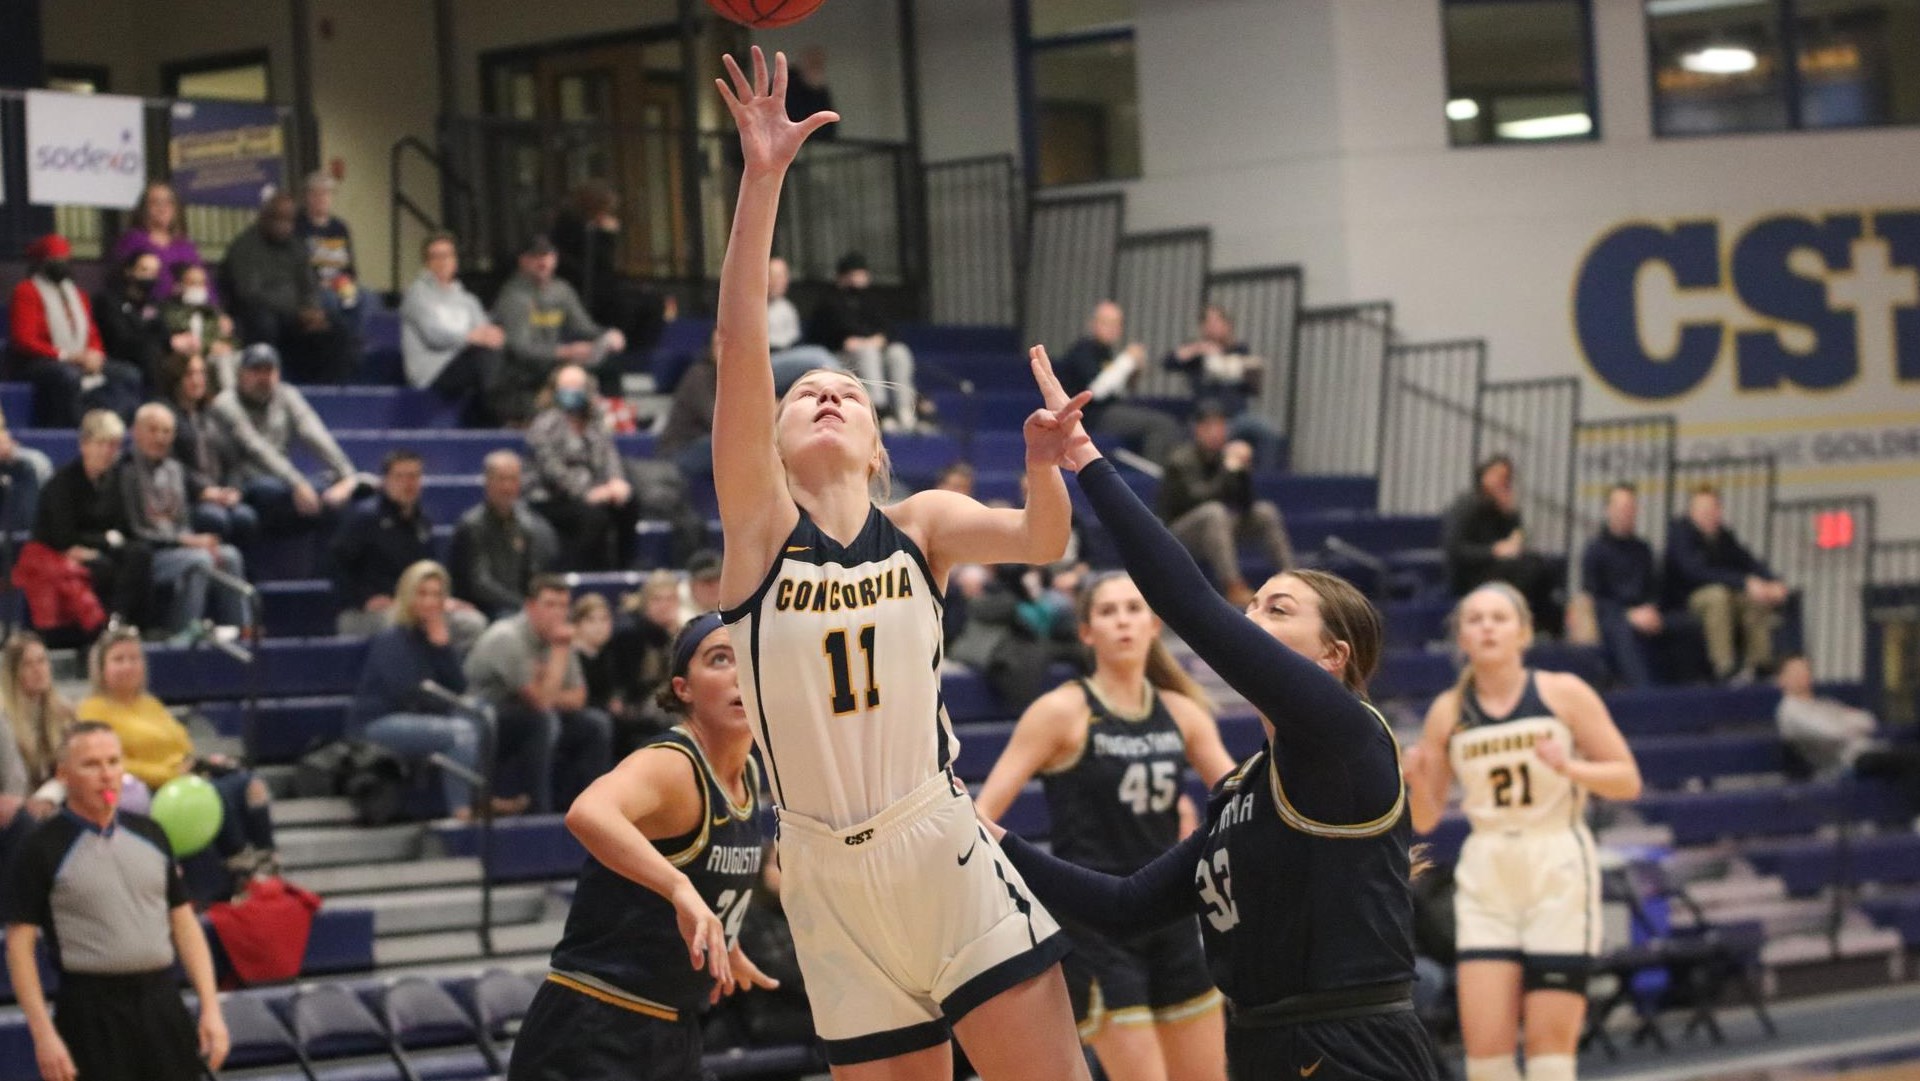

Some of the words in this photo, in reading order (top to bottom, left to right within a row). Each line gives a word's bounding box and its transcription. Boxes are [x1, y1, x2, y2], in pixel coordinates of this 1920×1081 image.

[822, 622, 881, 717] 11
[1462, 729, 1554, 759] CONCORDA
[1118, 761, 1177, 815] 45
[1488, 763, 1533, 808] 21
[844, 828, 874, 846] CST
[1195, 847, 1240, 933] 32
